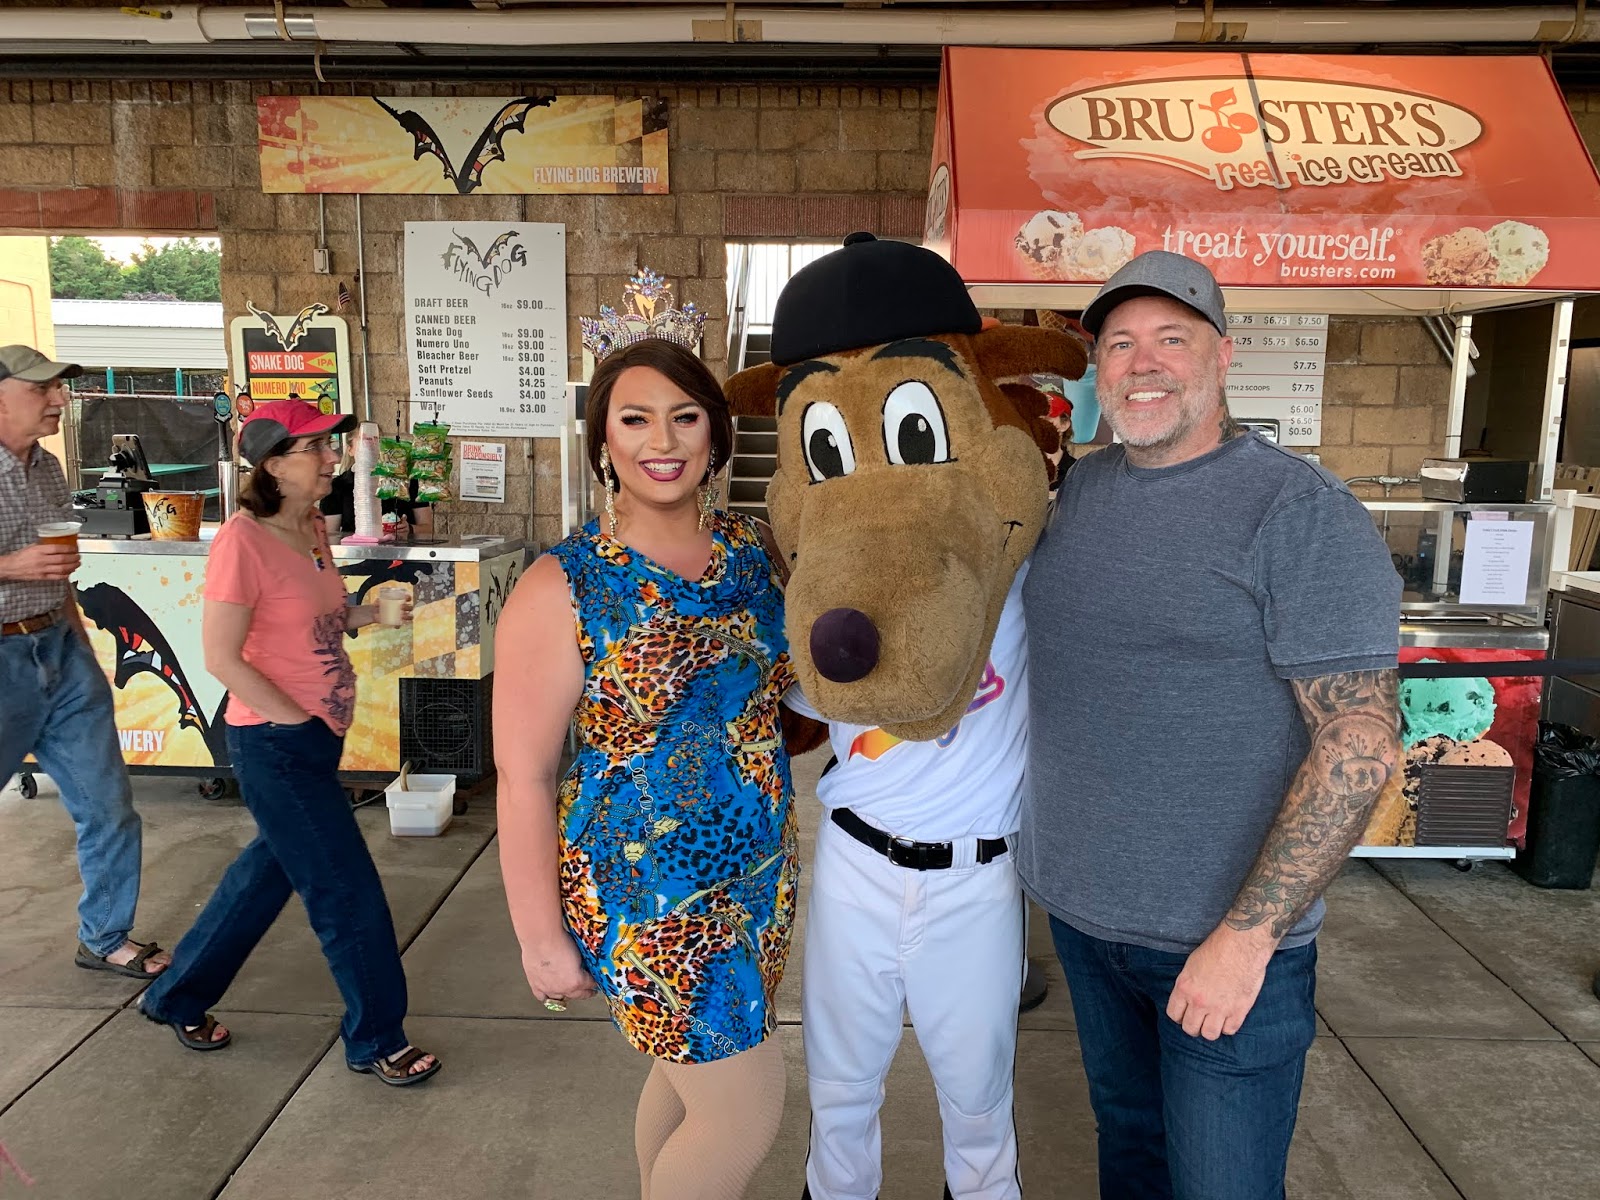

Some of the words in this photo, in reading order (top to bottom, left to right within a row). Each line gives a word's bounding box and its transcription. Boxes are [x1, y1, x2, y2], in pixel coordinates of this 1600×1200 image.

[1215, 151, 1285, 186] real
[1291, 153, 1343, 182] ice
[1348, 152, 1456, 179] cream
[533, 167, 574, 184] FLYING
[576, 167, 600, 183] DOG
[602, 166, 659, 184] BREWERY
[1161, 225, 1248, 259] treat
[1253, 227, 1396, 267] yourself.
[440, 242, 494, 297] FLYING
[493, 244, 528, 288] DOG
[1280, 262, 1396, 279] brusters.com
[414, 298, 443, 308] DRAFT
[446, 298, 469, 308] BEER
[516, 299, 543, 310] $9.00
[415, 314, 450, 324] CANNED
[454, 315, 476, 325] BEER
[1228, 315, 1253, 324] $5.75
[1263, 316, 1288, 325] $6.75
[1297, 316, 1322, 325] $7.50
[415, 326, 443, 336] Snake
[446, 327, 463, 338] Dog
[517, 328, 544, 339] $9.00
[416, 338, 450, 348] Numero
[453, 339, 470, 349] Uno
[517, 340, 544, 350] $9.00
[1233, 337, 1252, 346] 4.75
[1262, 336, 1286, 346] $5.75
[1295, 337, 1319, 346] $6.50
[417, 350, 455, 360] Bleacher
[459, 351, 480, 361] Beer
[518, 352, 545, 362] $9.00
[250, 354, 283, 371] SNAKE
[284, 354, 305, 371] DOG
[317, 358, 334, 367] IPA
[1293, 361, 1317, 370] $7.75
[418, 364, 437, 374] Soft
[440, 364, 472, 375] Pretzel
[518, 366, 545, 376] $4.00
[252, 381, 288, 395] NUMERO
[419, 376, 453, 386] Peanuts
[519, 378, 545, 388] $4.25
[1291, 383, 1315, 392] $7.75
[420, 387, 463, 398] Sunflower
[467, 388, 494, 399] Seeds
[519, 390, 546, 400] $4.00
[519, 403, 546, 413] $3.00
[1290, 405, 1314, 414] $6.00
[1288, 427, 1312, 436] $0.50
[463, 444, 482, 453] DRINK
[463, 451, 503, 461] RESPONSIBLY
[117, 729, 165, 752] WERY
